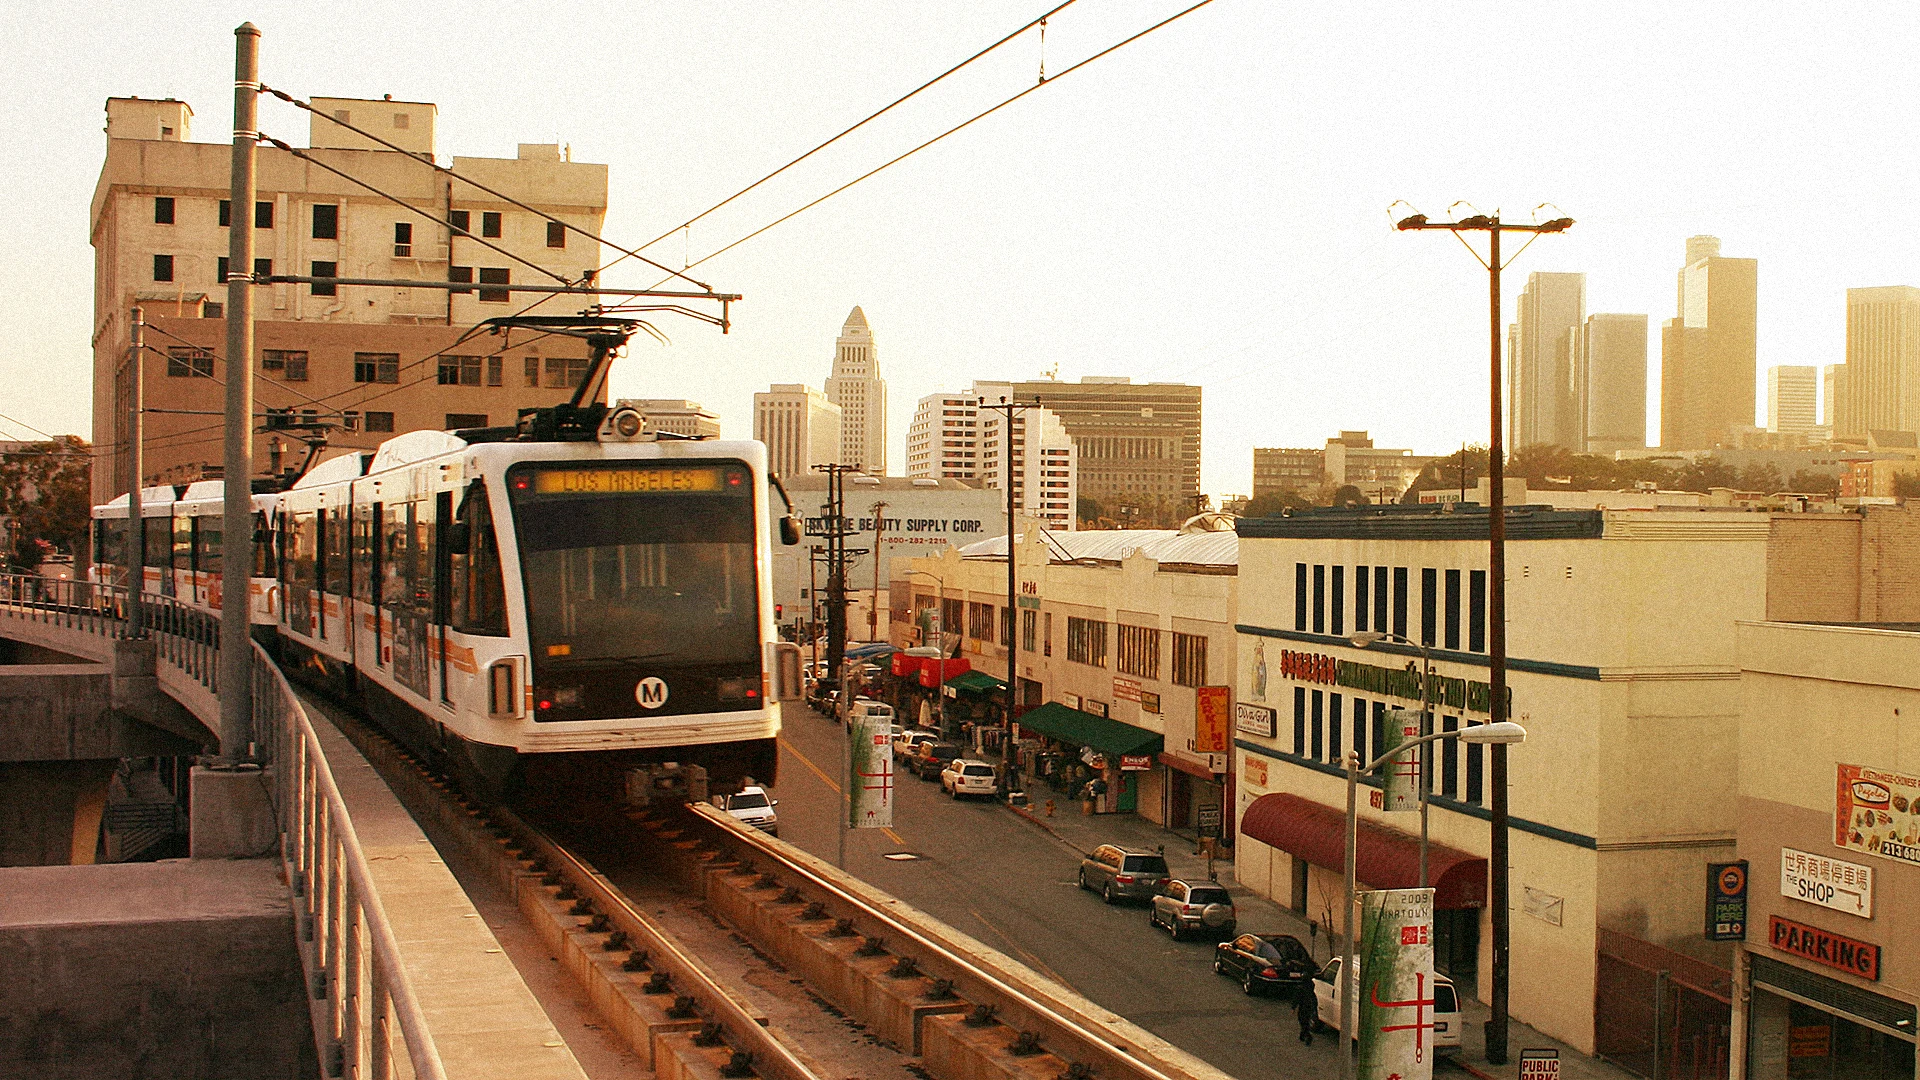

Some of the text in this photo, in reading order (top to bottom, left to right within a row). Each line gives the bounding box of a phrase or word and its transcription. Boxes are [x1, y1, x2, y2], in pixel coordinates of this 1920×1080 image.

[563, 471, 694, 491] LOS ANGELES
[810, 518, 984, 533] SKYNE BEAUTY SUPPLY CORP.
[642, 682, 662, 702] M
[1884, 843, 1902, 858] 213
[1785, 850, 1868, 891] 世界商場停車場
[1401, 894, 1428, 904] 2009
[1786, 874, 1834, 904] THE SHOP
[1774, 922, 1871, 973] PARKING
[1522, 1060, 1559, 1072] PUBLIC
